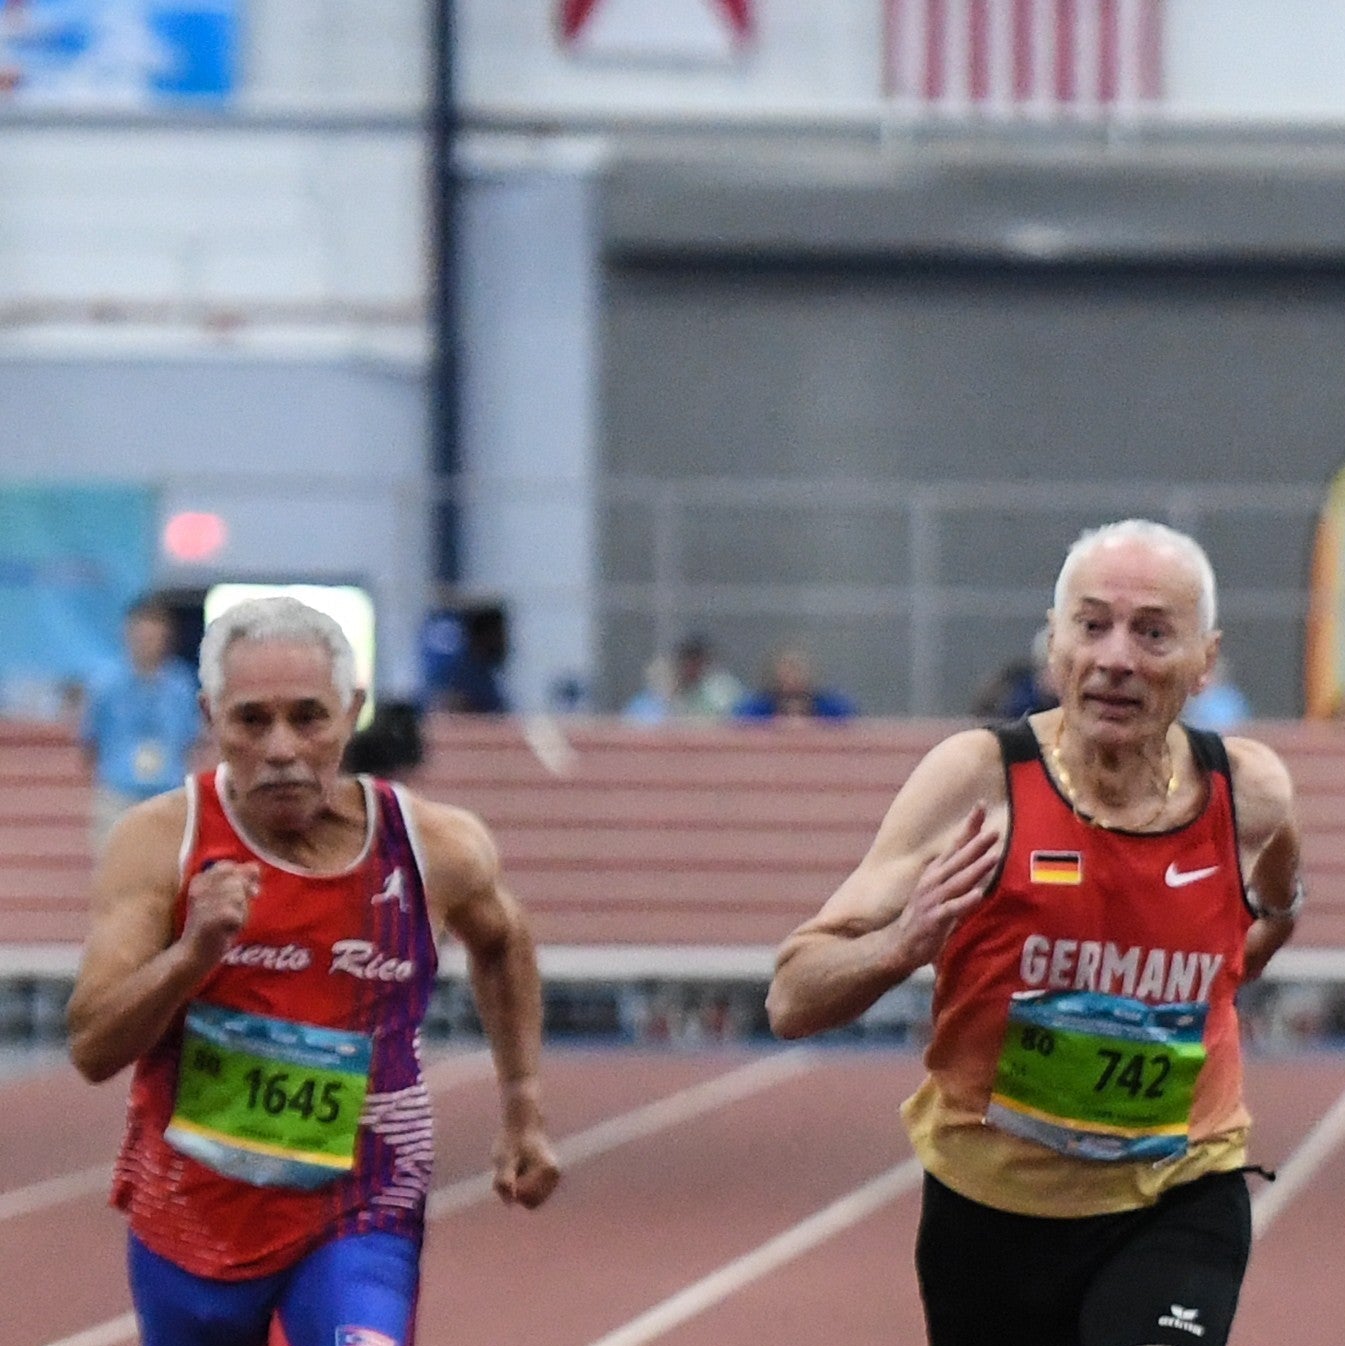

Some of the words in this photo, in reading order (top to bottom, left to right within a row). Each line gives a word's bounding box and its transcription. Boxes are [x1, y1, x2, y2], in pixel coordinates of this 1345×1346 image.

[224, 942, 313, 971] uerto
[328, 938, 415, 982] Rico
[1019, 934, 1224, 1004] GERMANY
[1021, 1026, 1055, 1056] 80
[244, 1067, 343, 1124] 1645
[1094, 1050, 1172, 1100] 742
